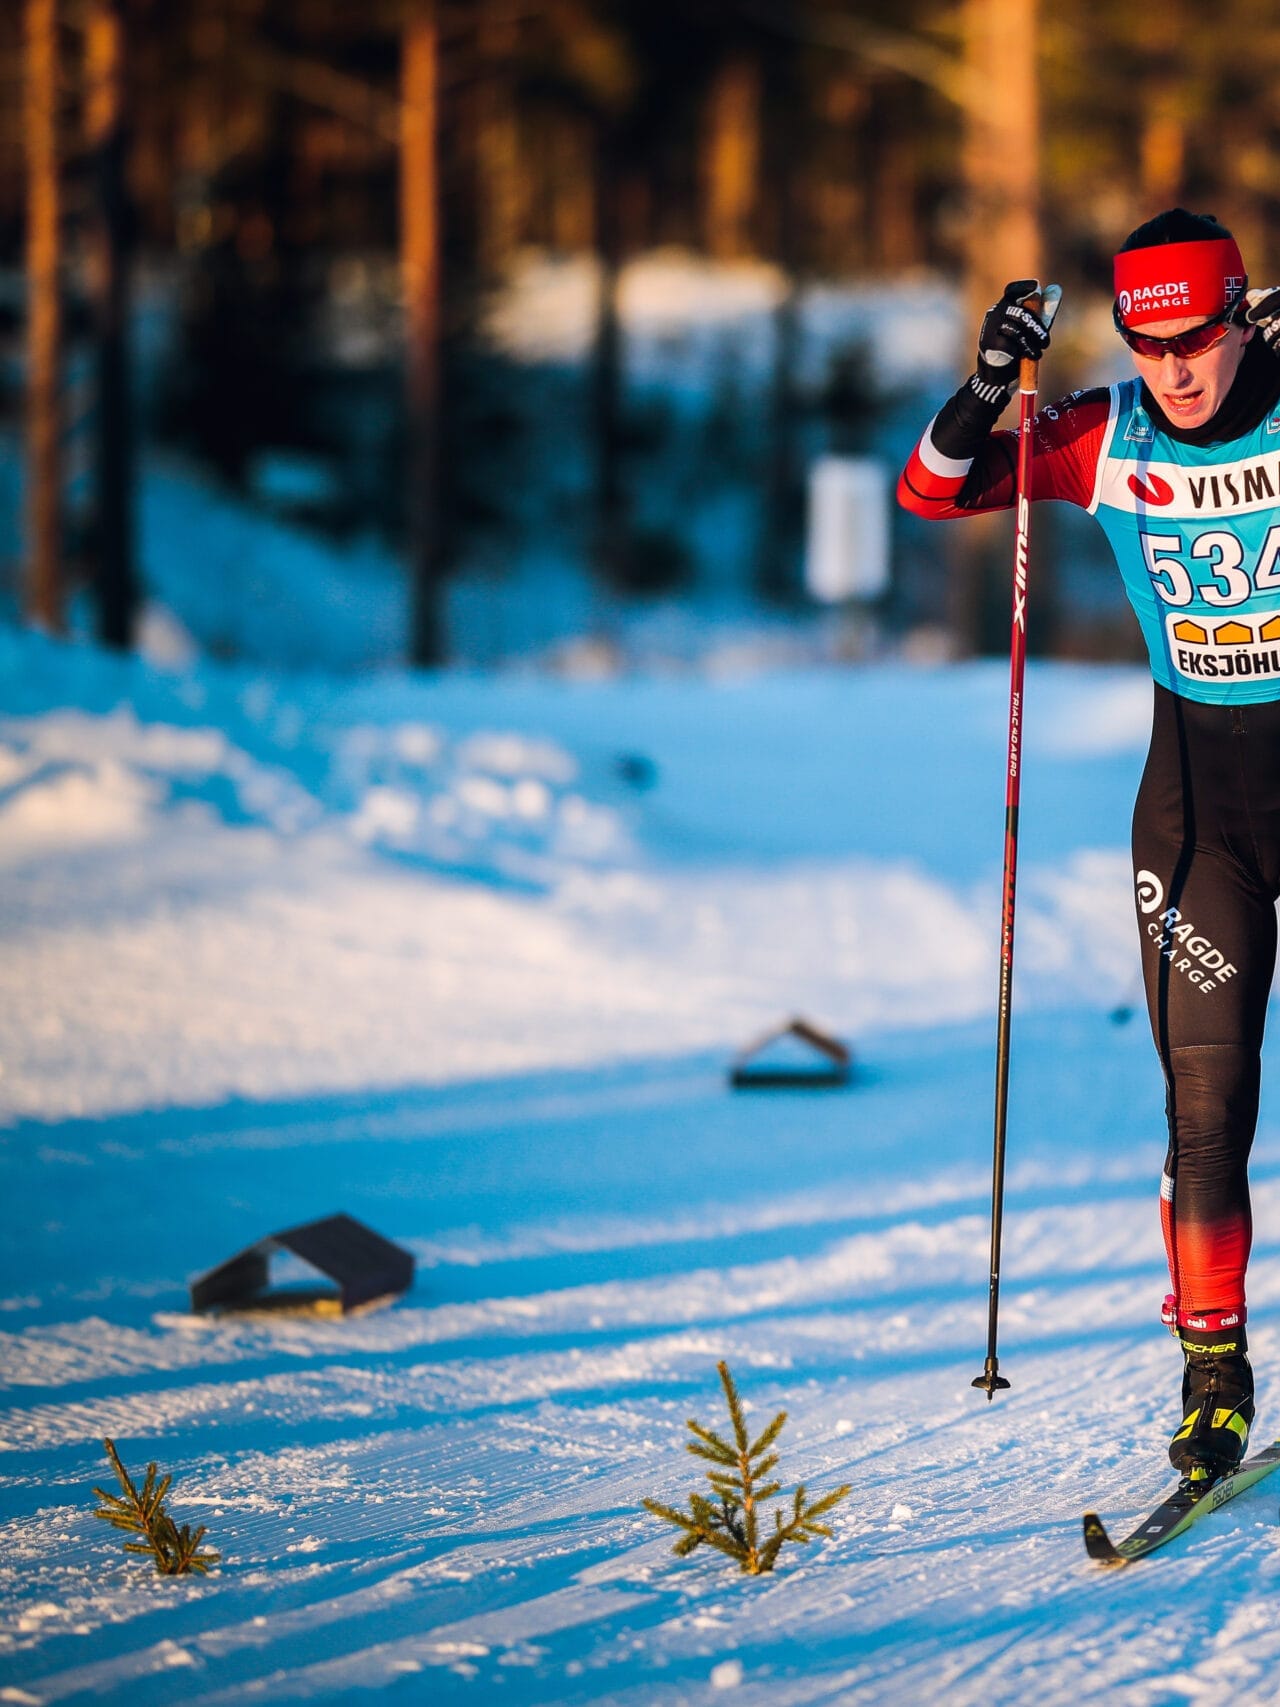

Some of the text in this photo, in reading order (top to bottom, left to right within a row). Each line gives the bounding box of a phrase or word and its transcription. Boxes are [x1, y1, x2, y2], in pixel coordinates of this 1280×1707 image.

[1133, 281, 1190, 301] RAGDE
[1134, 296, 1191, 313] CHARGE
[1011, 691, 1020, 727] TRIAC
[1147, 922, 1217, 995] CHARGE
[1158, 906, 1239, 984] RAGDE
